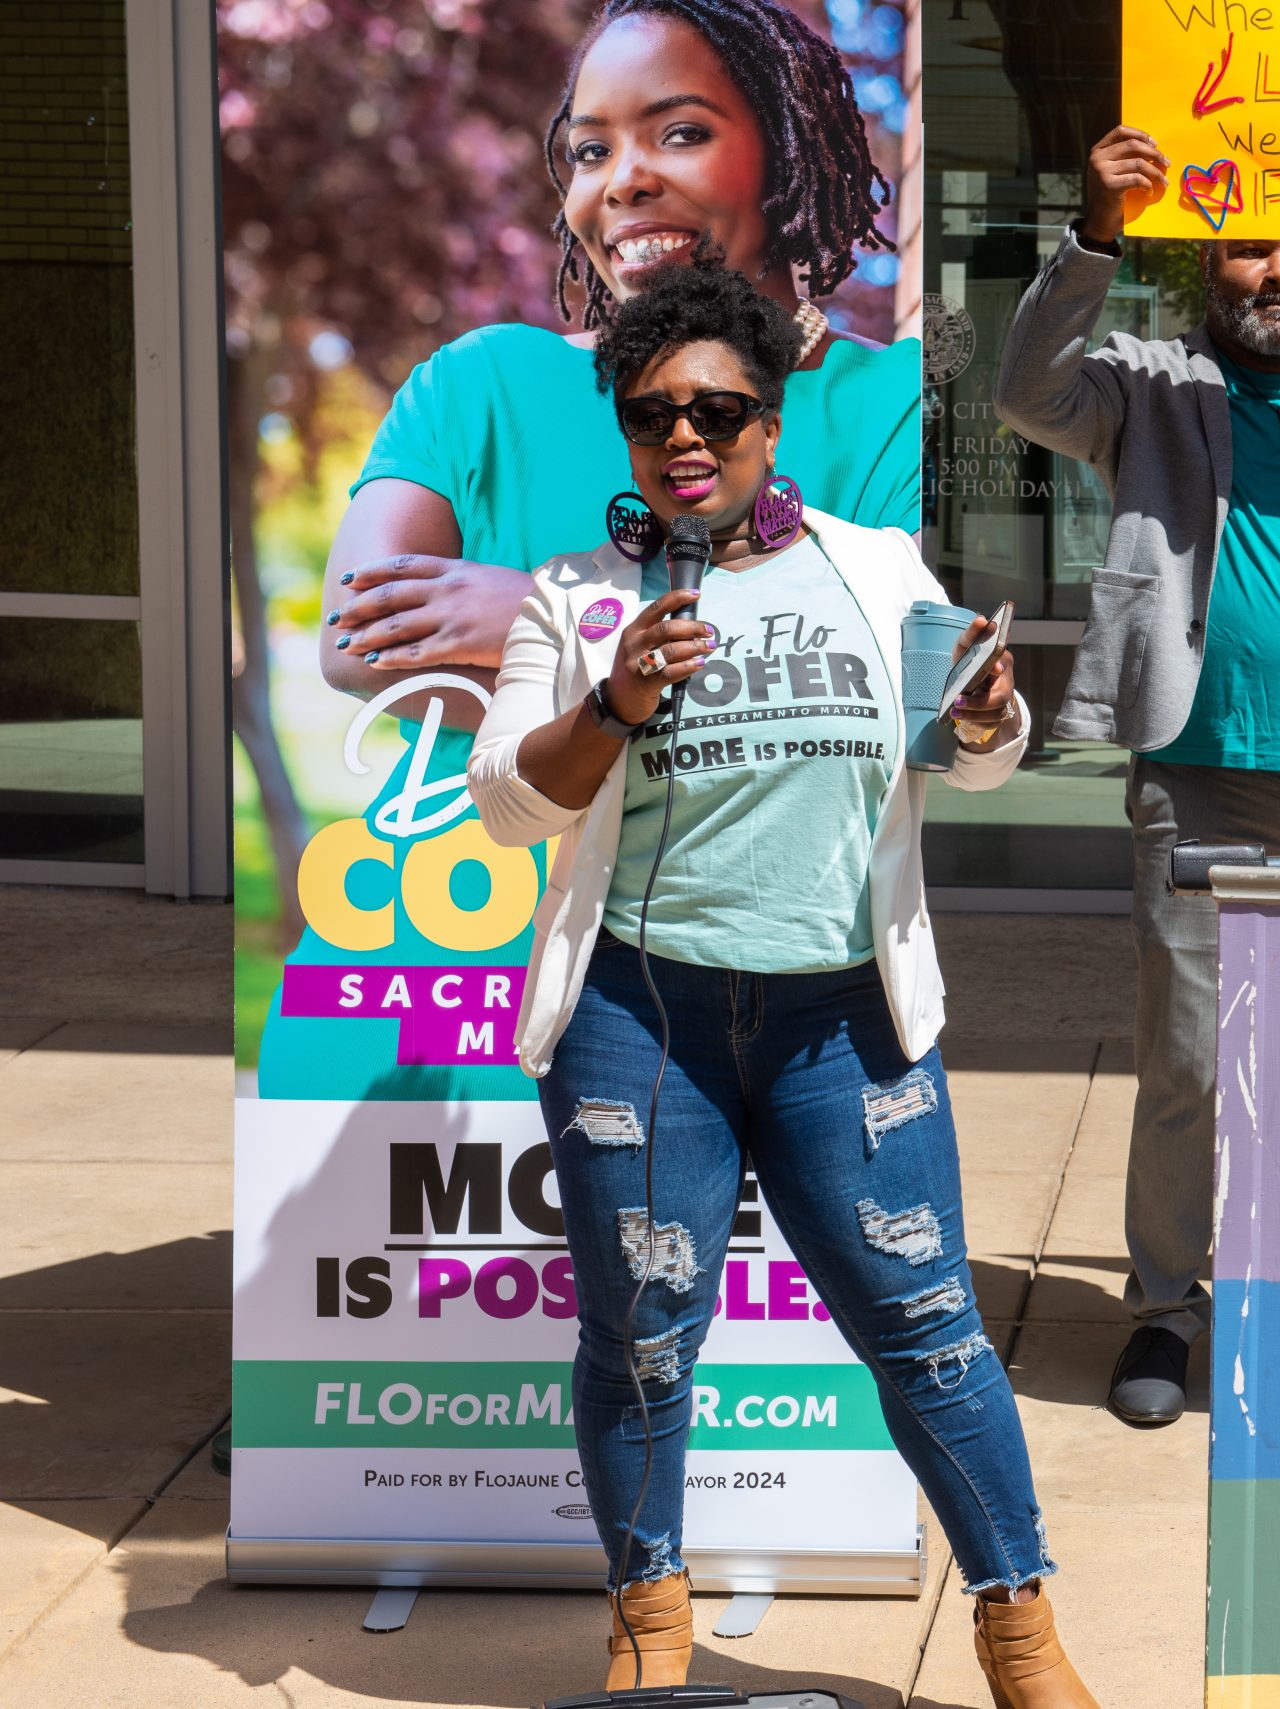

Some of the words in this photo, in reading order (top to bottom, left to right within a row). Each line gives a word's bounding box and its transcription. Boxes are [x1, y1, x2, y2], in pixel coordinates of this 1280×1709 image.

[953, 402, 996, 420] CIT
[953, 437, 1031, 455] FRIDAY
[940, 459, 980, 476] 5:00
[988, 460, 1019, 477] PM
[582, 613, 617, 625] COFER
[760, 612, 837, 659] Flo
[654, 652, 875, 715] OFER
[696, 707, 810, 727] SACRAMENTO
[820, 706, 870, 717] MAYOR
[640, 737, 744, 778] MORE
[755, 742, 776, 761] IS
[317, 1256, 392, 1318] IS
[685, 1476, 726, 1488] AYOR
[733, 1472, 786, 1488] 2024
